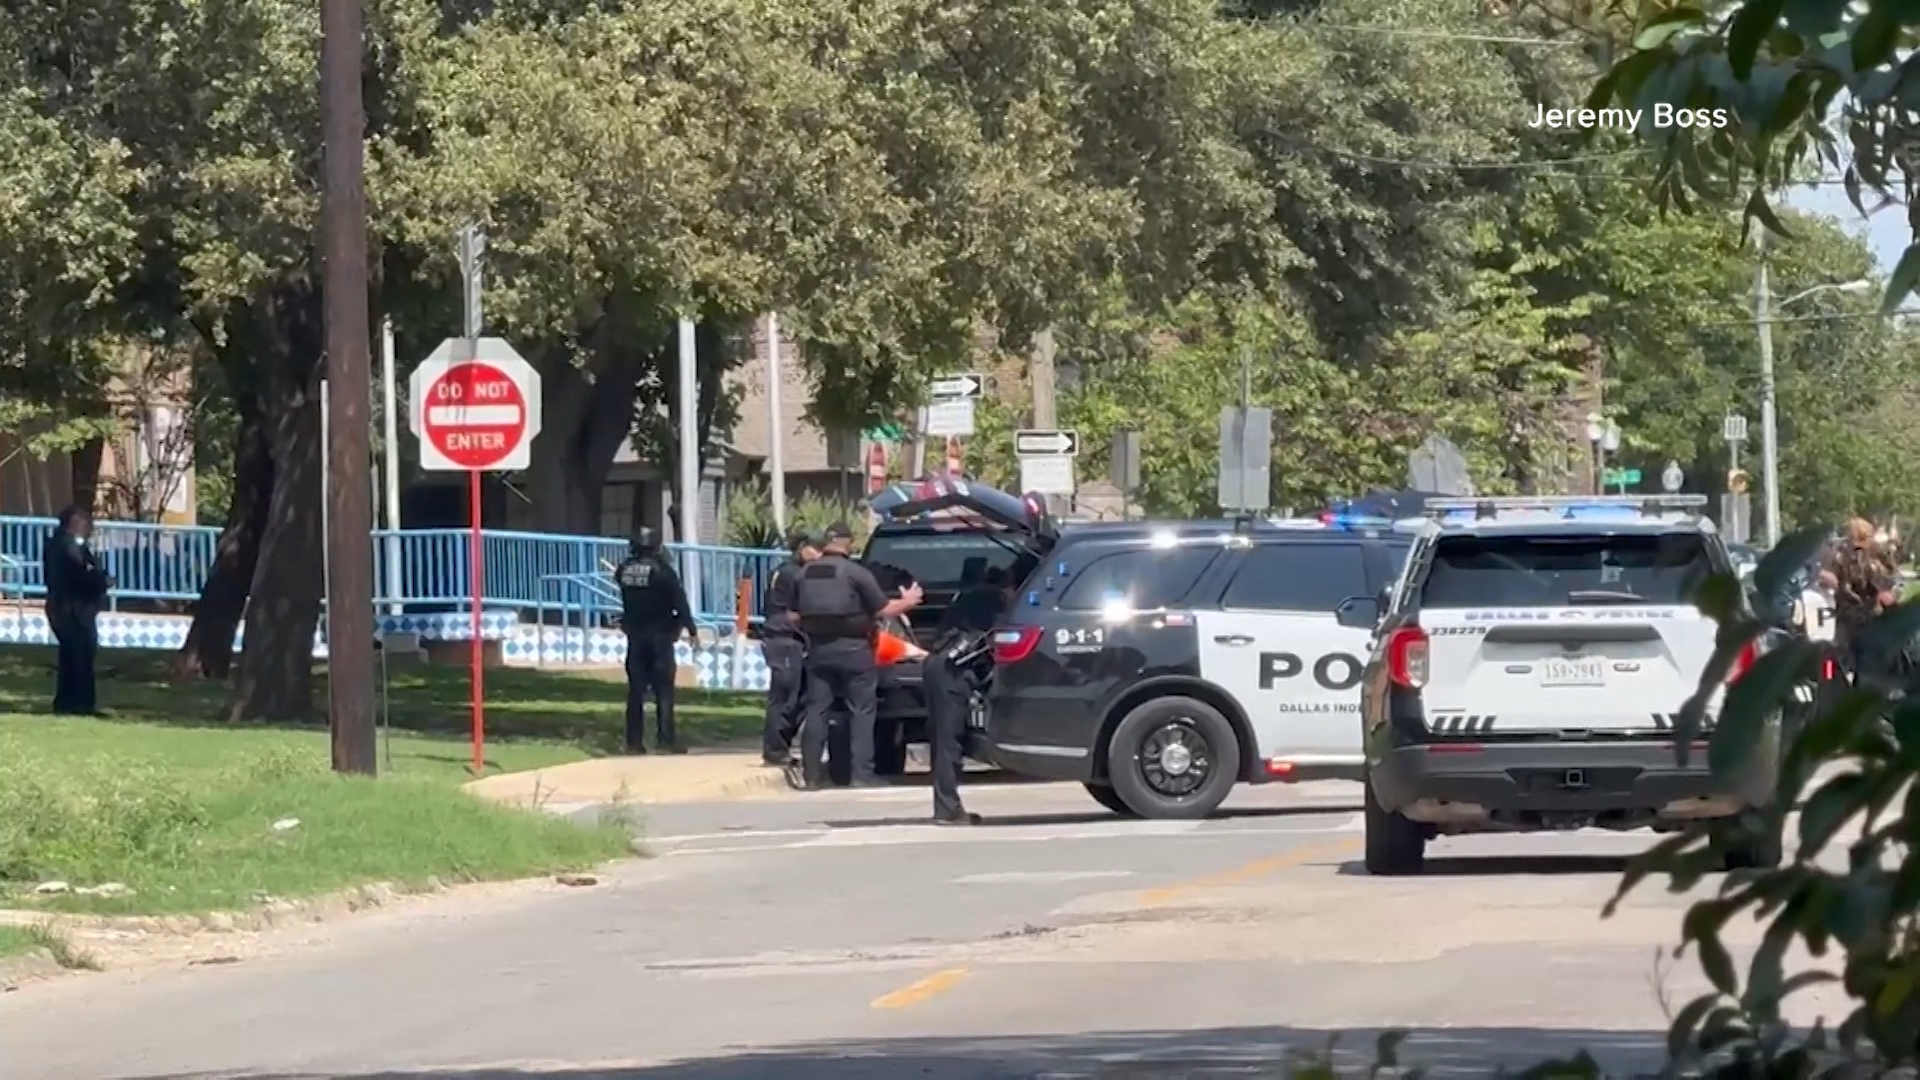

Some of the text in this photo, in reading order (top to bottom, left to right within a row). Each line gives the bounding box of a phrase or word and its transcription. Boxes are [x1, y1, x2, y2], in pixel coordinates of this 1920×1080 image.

[437, 381, 510, 399] DO NOT
[446, 432, 505, 450] ENTER
[1279, 703, 1330, 713] DALLAS
